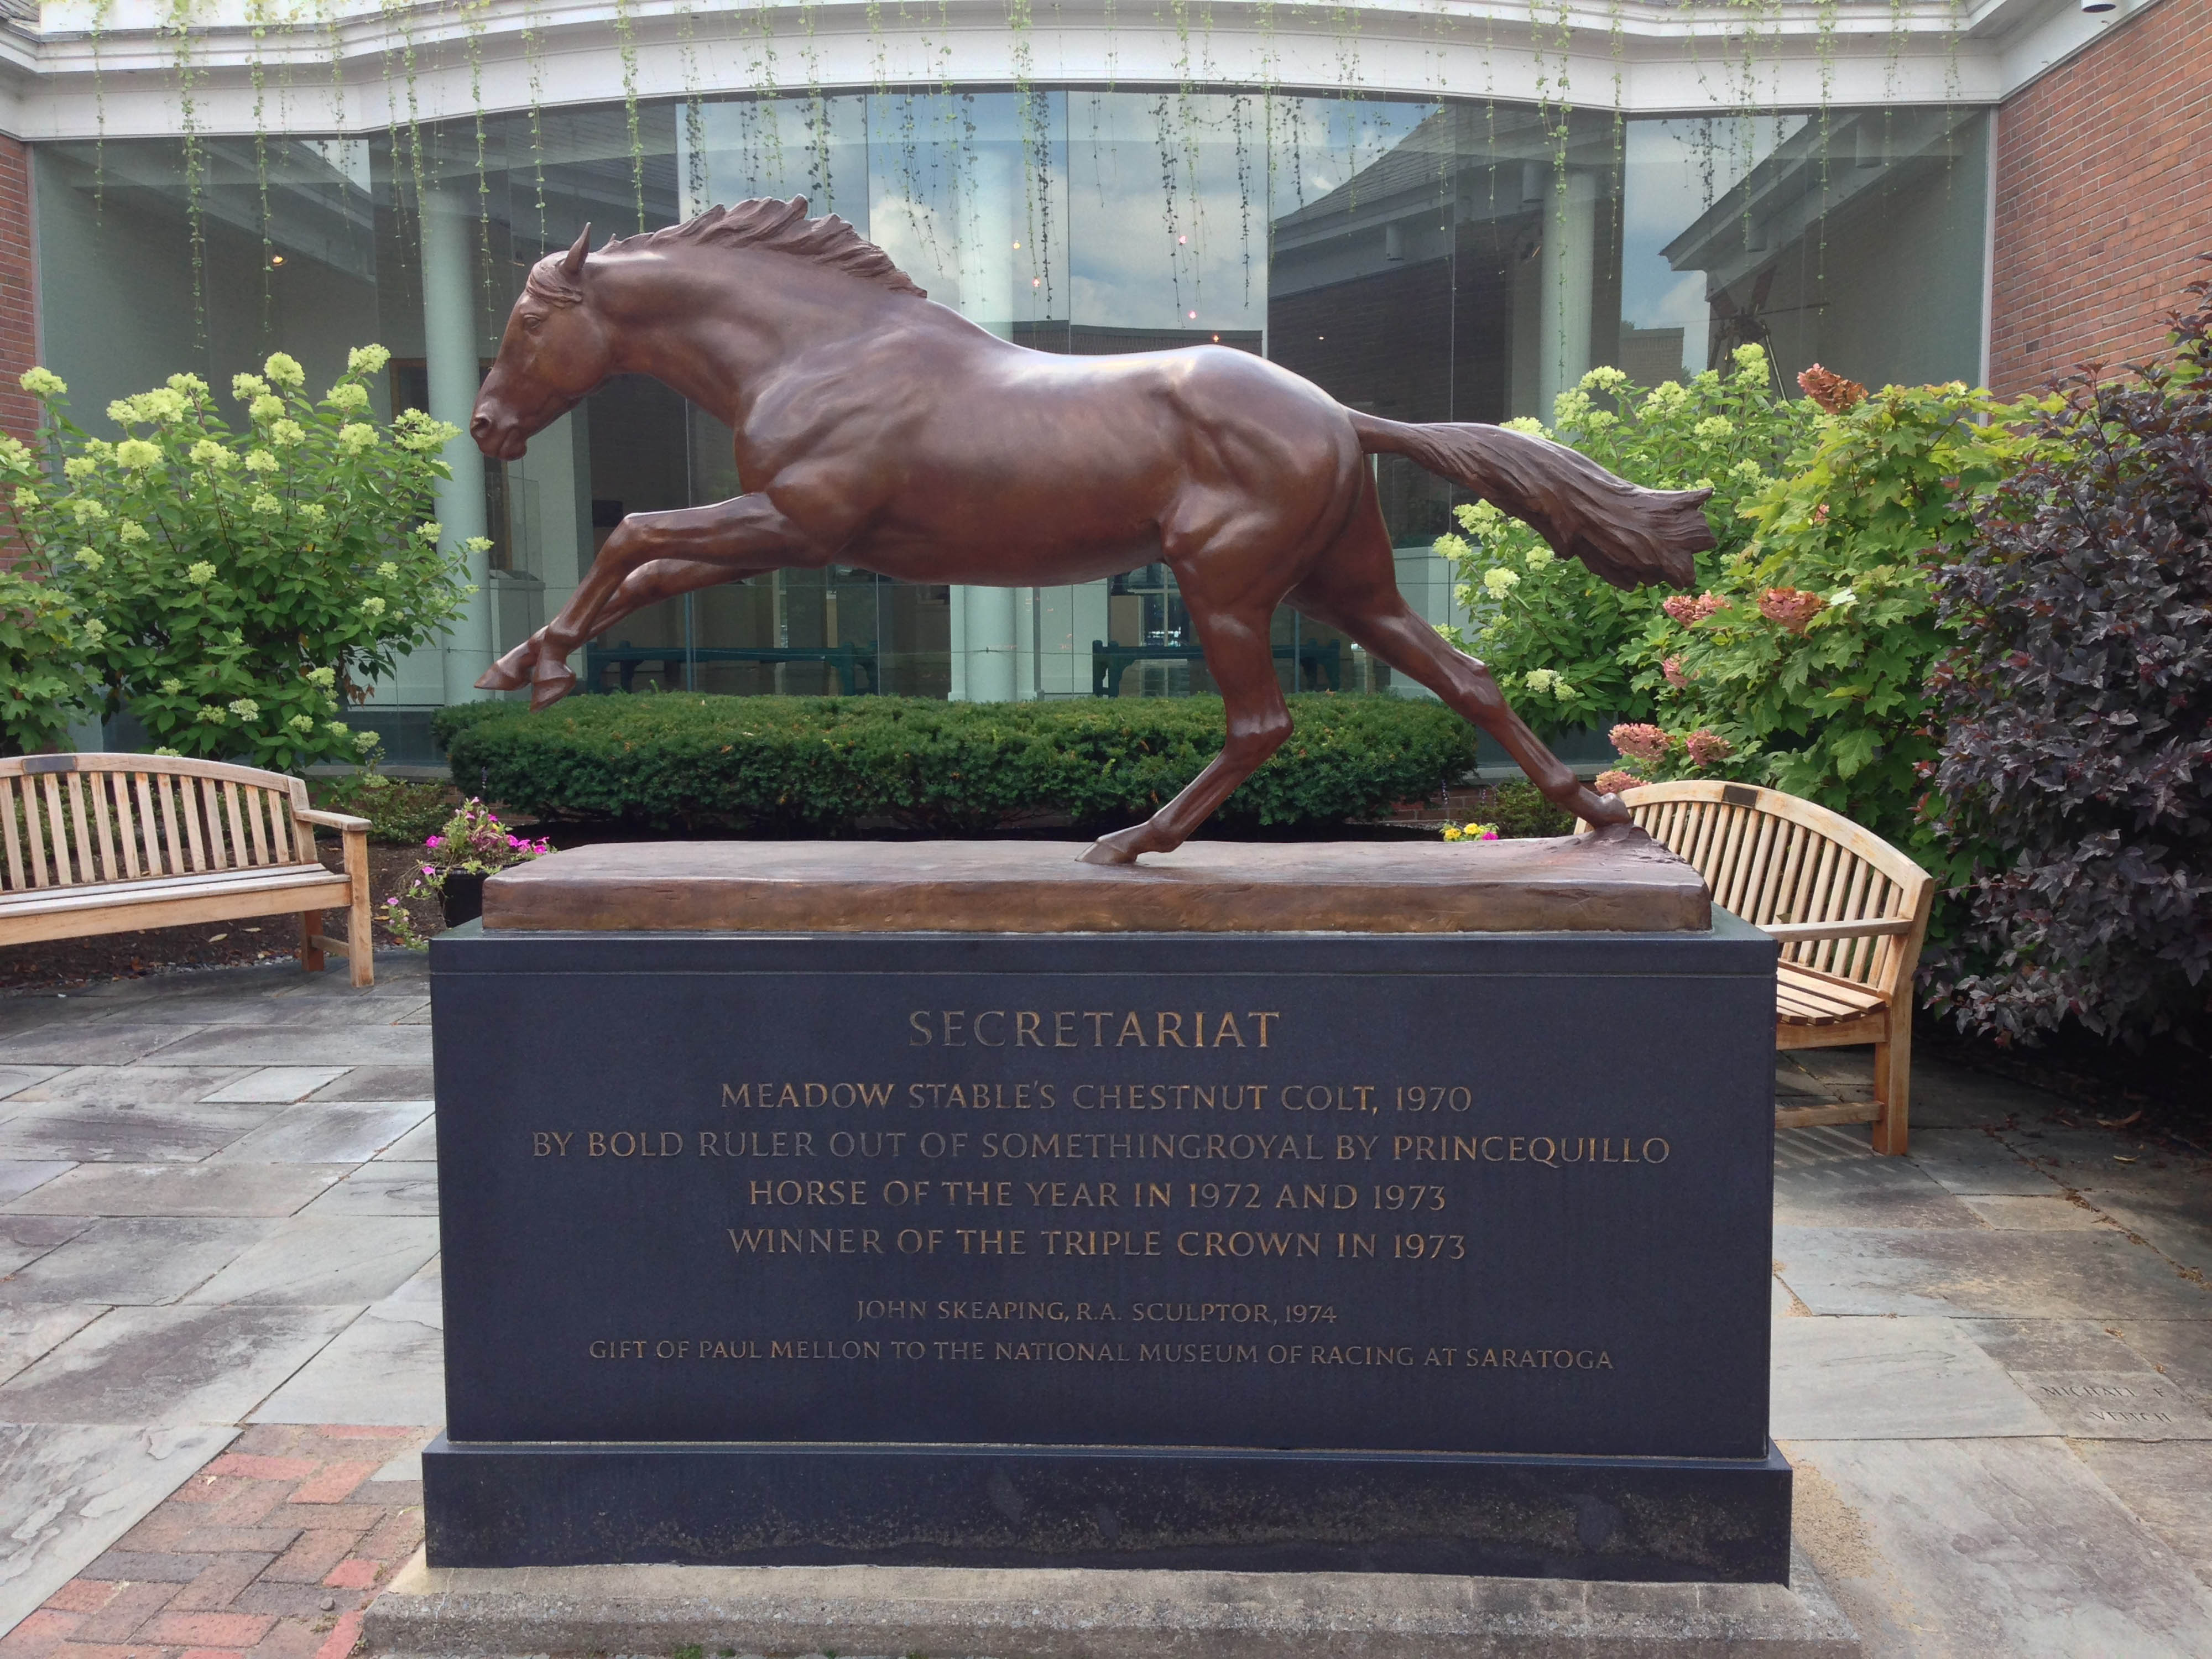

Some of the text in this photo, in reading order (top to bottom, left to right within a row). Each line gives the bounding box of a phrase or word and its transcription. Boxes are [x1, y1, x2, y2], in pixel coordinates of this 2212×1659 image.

[909, 1010, 1281, 1048] SECRETARIAT
[721, 1080, 1472, 1115] MEADOW STABLE'S CHESTNUT COLT, 1970
[533, 1131, 1671, 1168] BY BOLD RULER OUT OF SOMETHINGROYAL BY PRINCEQUILLO
[750, 1180, 1446, 1211] HORSE OF THE YEAR IN 1972 AND 1973
[727, 1228, 1465, 1260] WINNER OF THE TRIPLE CROWN IN 1973
[858, 1300, 1337, 1326] JOHN SKEAPING, R.A. SCULPTOR, 1974
[589, 1340, 1613, 1369] GIFT OF PAUL MELLON TO THE NATIONAL MUSEUM OF RACING AT SARATOGA
[2040, 1386, 2140, 1398] MICHAEL
[2089, 1411, 2172, 1422] VEITCH
